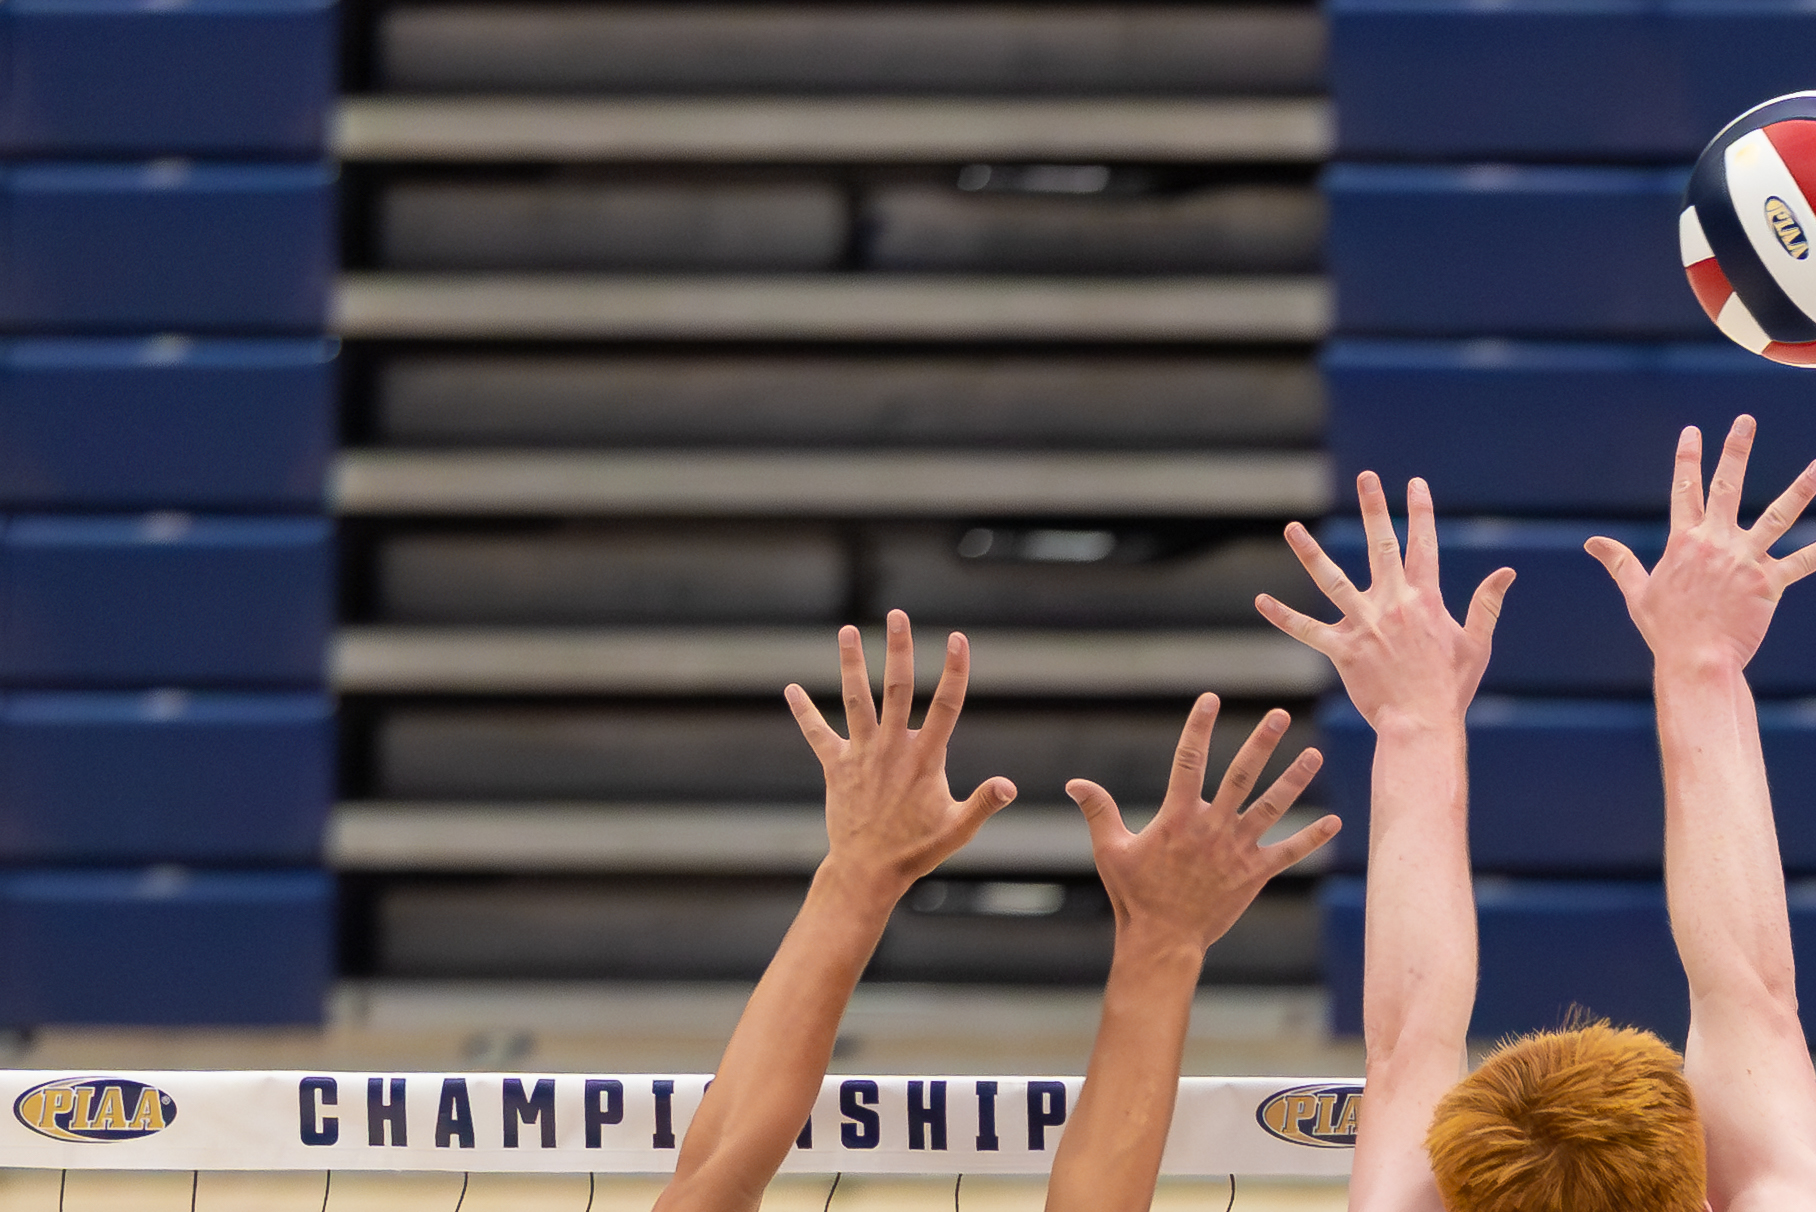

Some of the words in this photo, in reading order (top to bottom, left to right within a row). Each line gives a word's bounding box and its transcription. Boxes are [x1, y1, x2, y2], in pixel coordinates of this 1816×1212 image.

[38, 1086, 166, 1130] PIAA
[299, 1076, 1067, 1152] CHAMPISHIP
[1281, 1093, 1363, 1136] PIA
